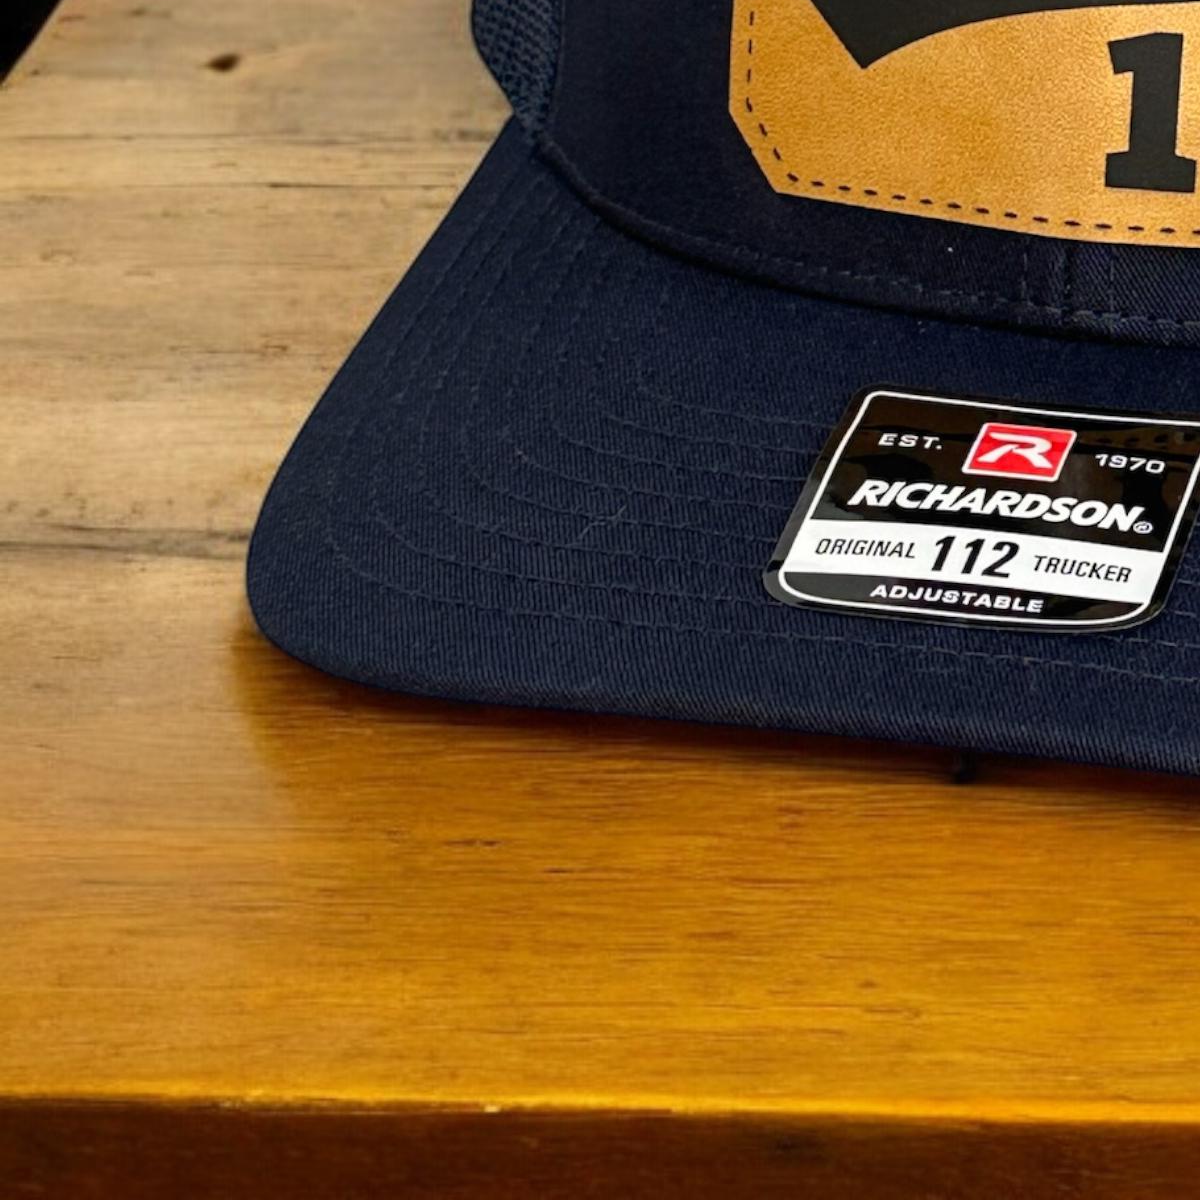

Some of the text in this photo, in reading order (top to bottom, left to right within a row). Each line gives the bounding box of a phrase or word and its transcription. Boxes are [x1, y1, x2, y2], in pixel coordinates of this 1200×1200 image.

[878, 431, 1166, 474] EST. R 1970
[815, 535, 1132, 583] ORIGINAL 112 TRUCKER
[870, 583, 1044, 613] ADJUSTABLE
